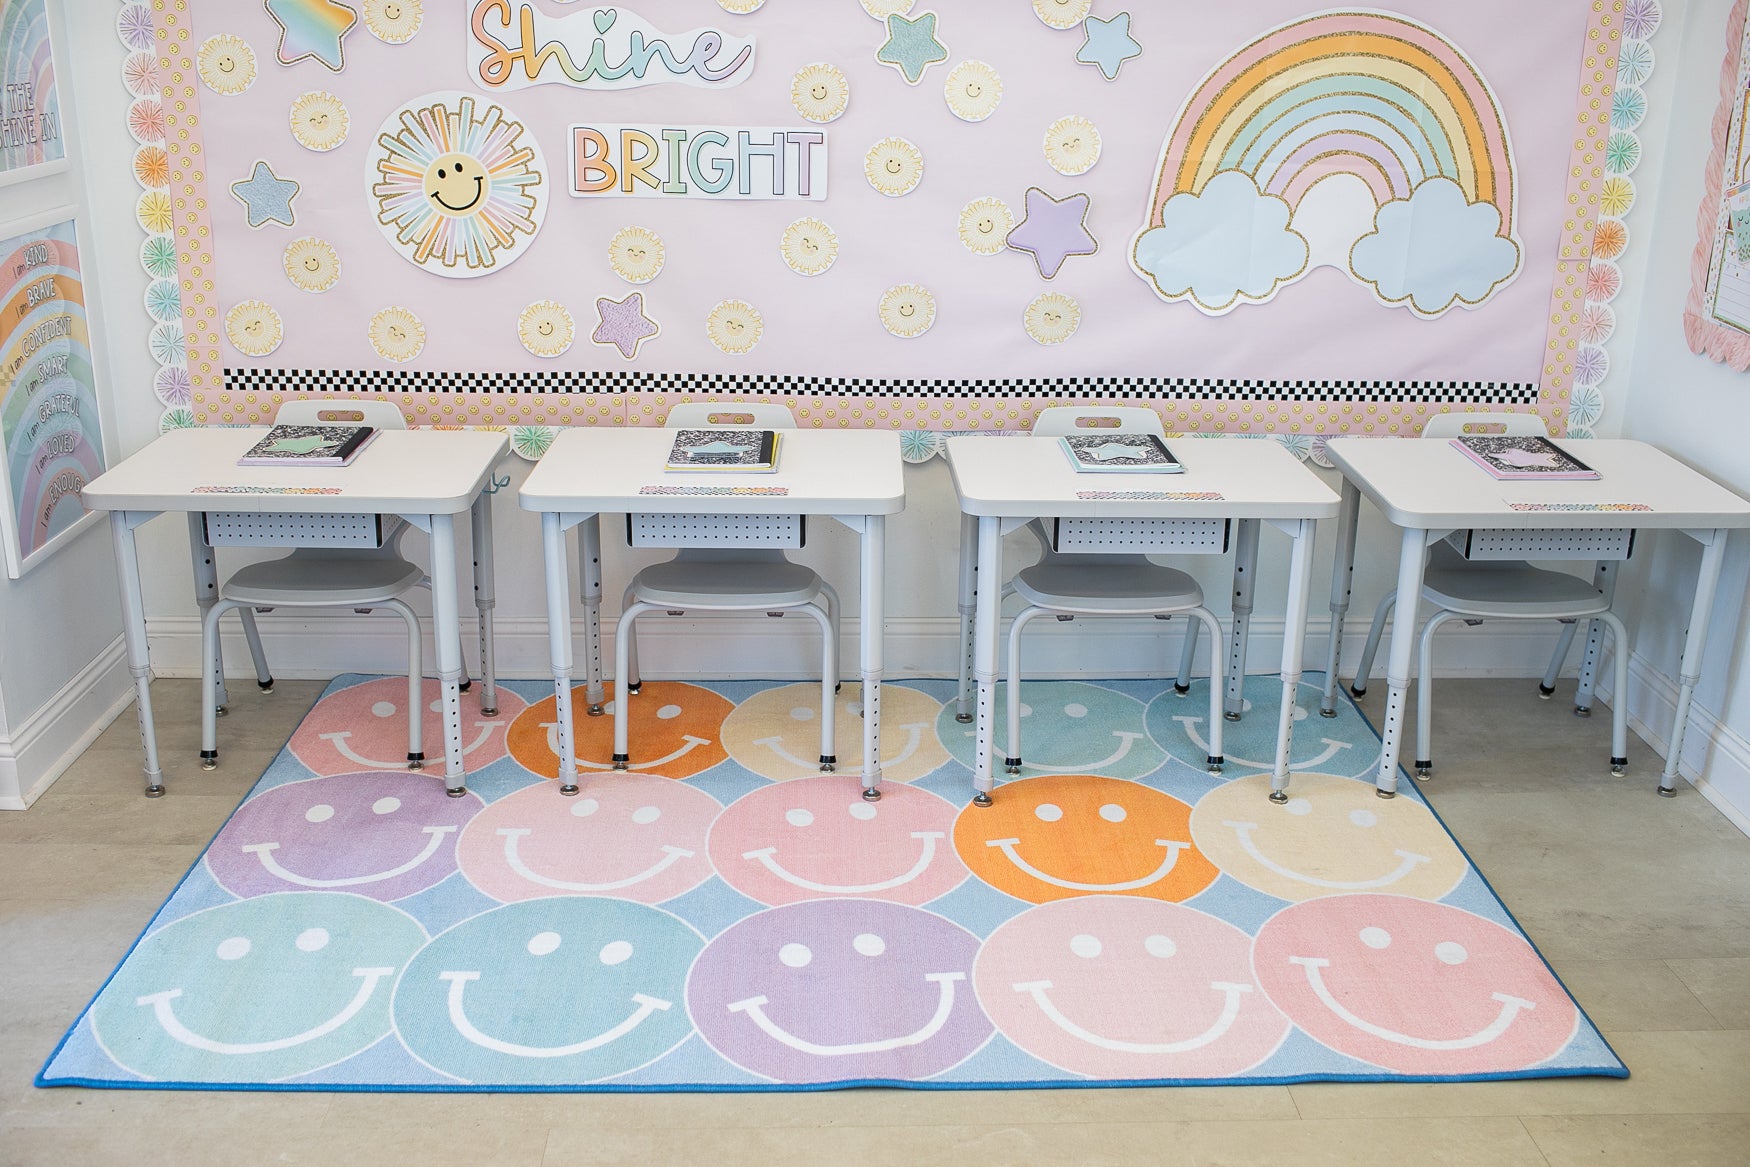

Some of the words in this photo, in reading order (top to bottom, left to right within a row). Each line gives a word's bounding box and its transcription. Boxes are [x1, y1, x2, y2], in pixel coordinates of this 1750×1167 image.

[471, 0, 752, 87] Shine
[7, 82, 34, 113] THE
[0, 115, 37, 148] HINE
[39, 112, 57, 141] IN
[573, 127, 824, 196] BRIGHT
[17, 264, 26, 275] am
[24, 244, 48, 270] KIND
[20, 303, 28, 315] am
[27, 278, 56, 307] BRAVE
[15, 356, 24, 369] am
[22, 316, 72, 357] CONFIDENT
[30, 379, 38, 391] am
[38, 355, 68, 383] SMART
[31, 423, 40, 436] am
[39, 393, 80, 423] GRATEFUL
[40, 455, 48, 469] am
[47, 434, 75, 458] LOVED
[43, 503, 52, 520] am
